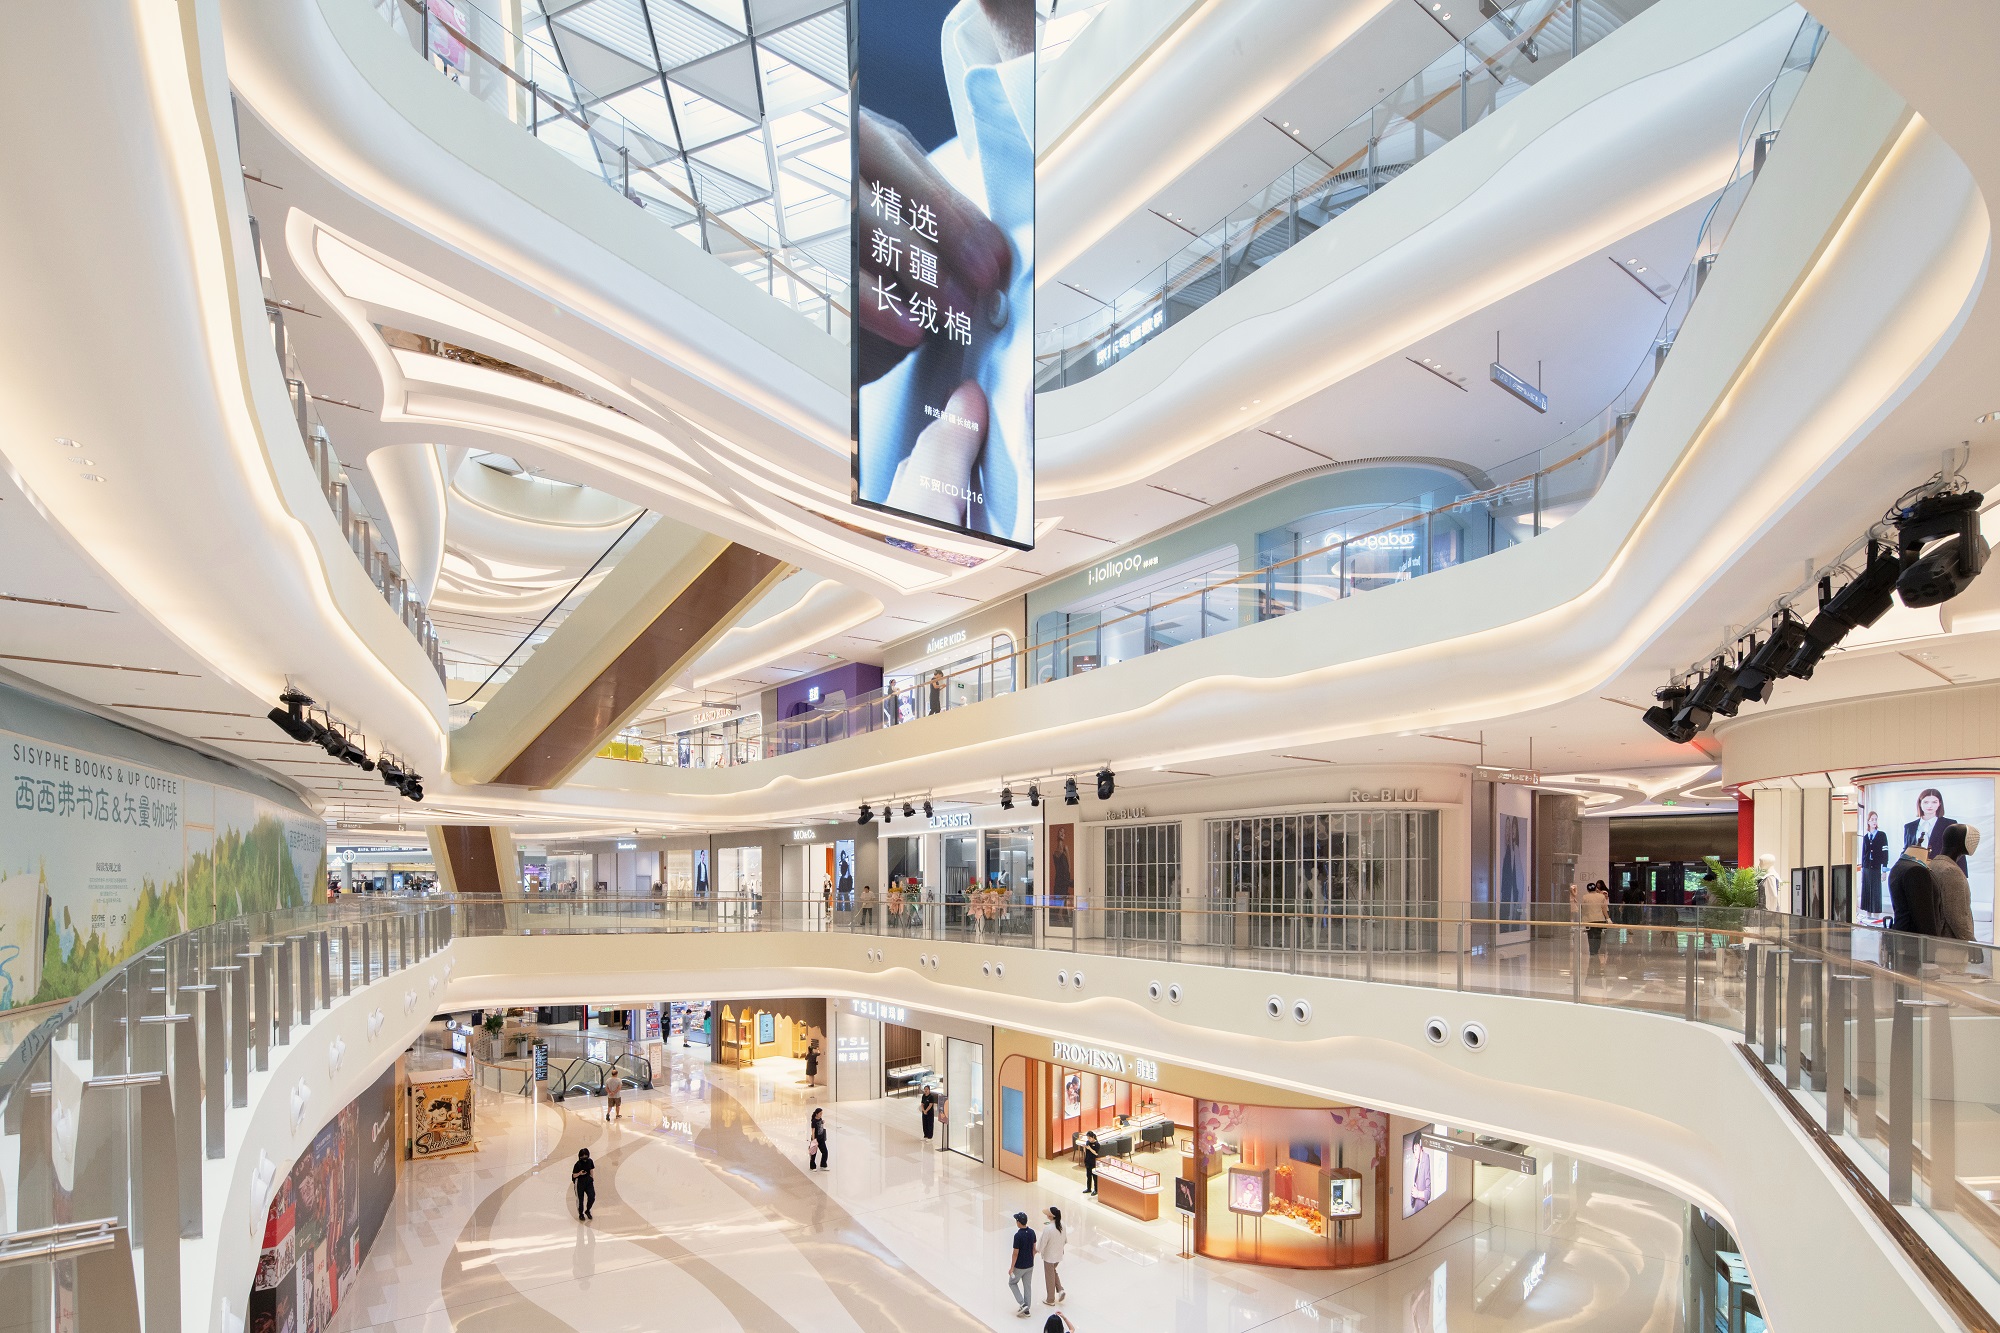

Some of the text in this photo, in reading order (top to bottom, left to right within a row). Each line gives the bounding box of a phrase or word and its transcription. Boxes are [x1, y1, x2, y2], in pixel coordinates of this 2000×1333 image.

[870, 180, 938, 243] 精选
[871, 228, 938, 288] 新疆
[871, 275, 971, 345] 长绒棉
[924, 404, 979, 432] 精选新疆长绒棉
[961, 488, 983, 504] L216
[949, 630, 967, 646] KIDS
[13, 743, 177, 794] SISYPHE BOOKS & UP COFFEE
[14, 775, 178, 830] 西西弗书店&矢量咖啡
[1349, 788, 1423, 802] Re-BLUE
[1105, 807, 1146, 820] Re-BLUE
[852, 999, 875, 1015] TSL
[838, 1036, 869, 1047] TSL
[1052, 1041, 1158, 1081] PROMESSA 周生生
[1520, 1165, 1529, 1174] L1
